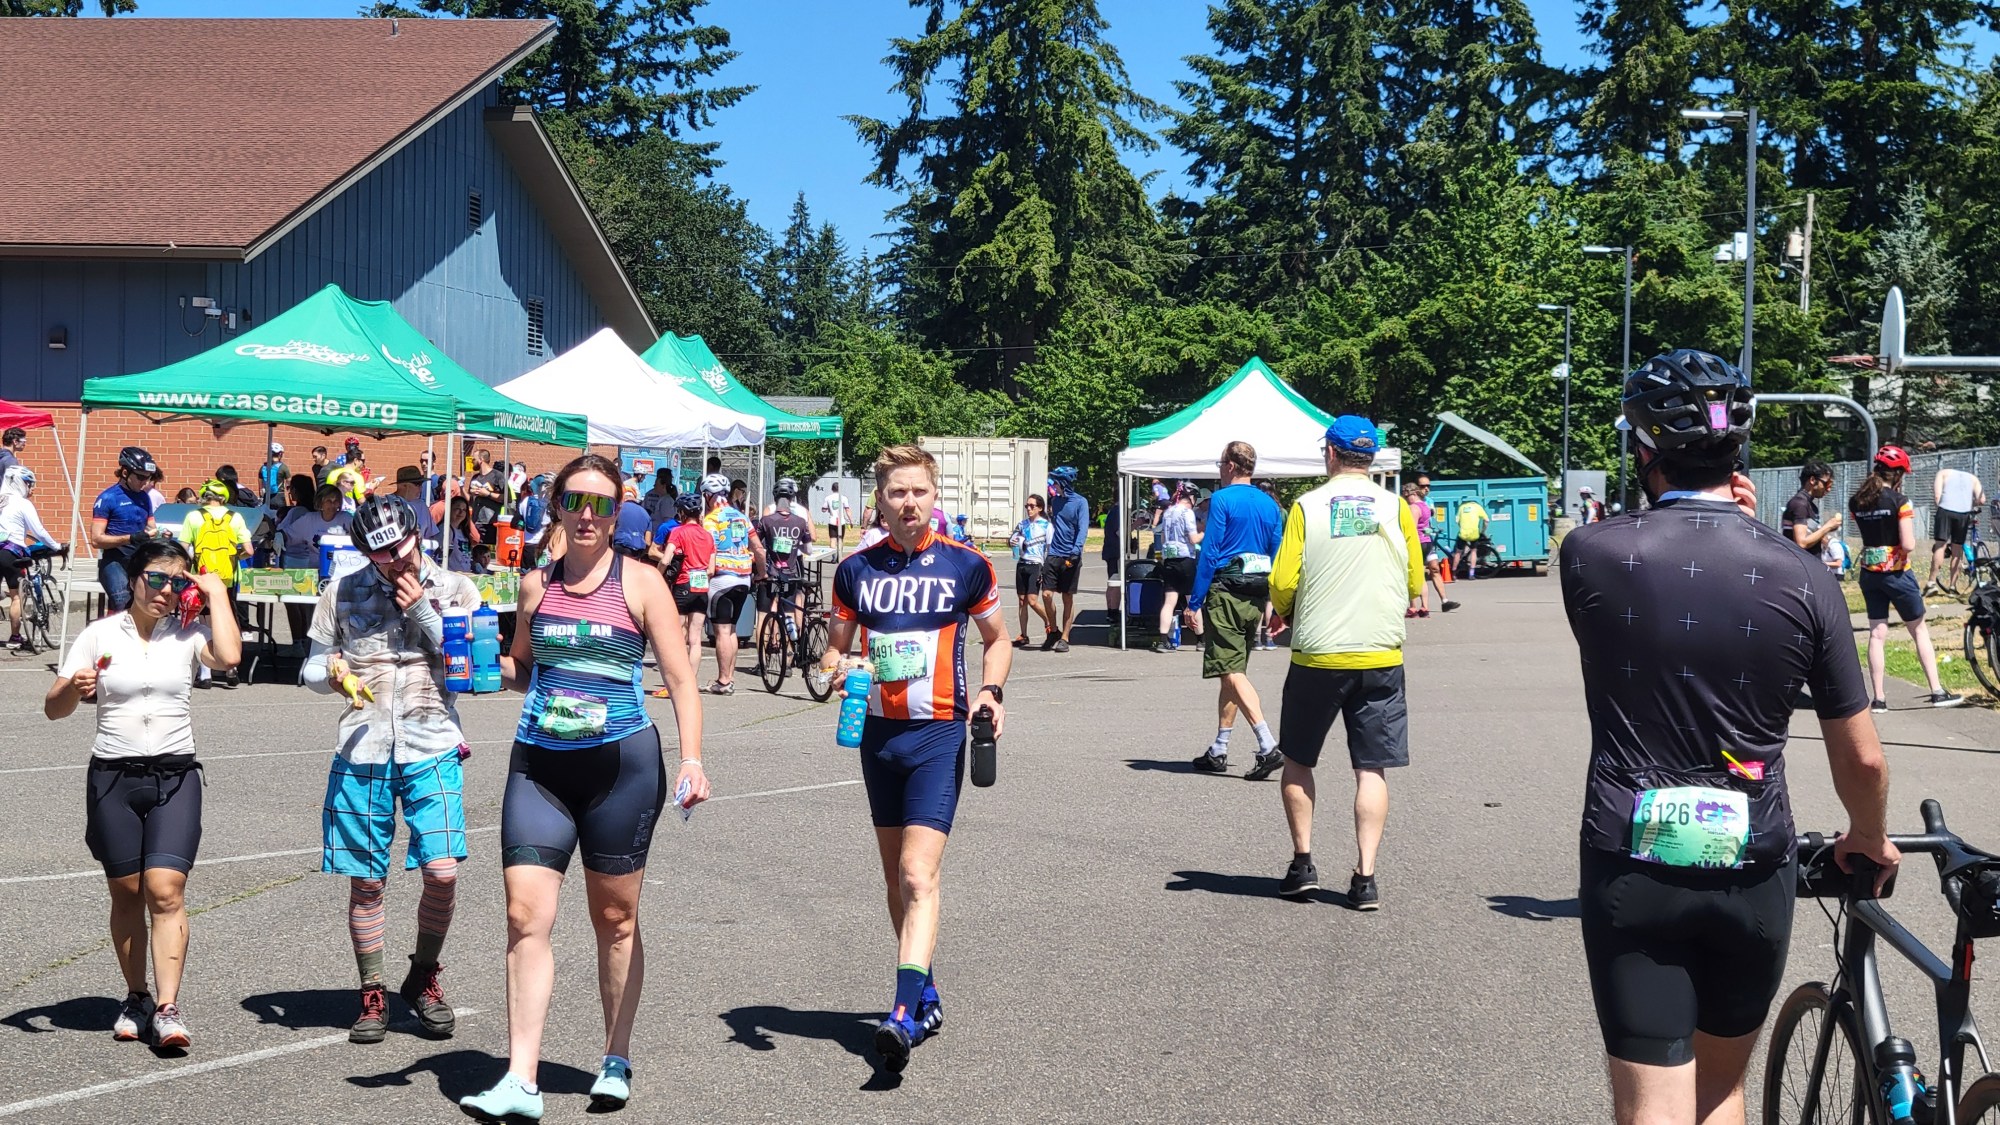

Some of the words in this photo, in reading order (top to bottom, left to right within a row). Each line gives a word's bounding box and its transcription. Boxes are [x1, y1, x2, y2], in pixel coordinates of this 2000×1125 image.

[138, 392, 399, 425] www.cascade.org
[494, 412, 557, 440] www.cascade.org
[1333, 508, 1355, 519] 2901
[370, 527, 397, 546] 1919
[773, 527, 800, 539] VELO
[858, 576, 956, 614] NORTE
[544, 619, 612, 637] IRONMAN
[871, 644, 892, 661] 3491
[1641, 802, 1690, 826] 6126
